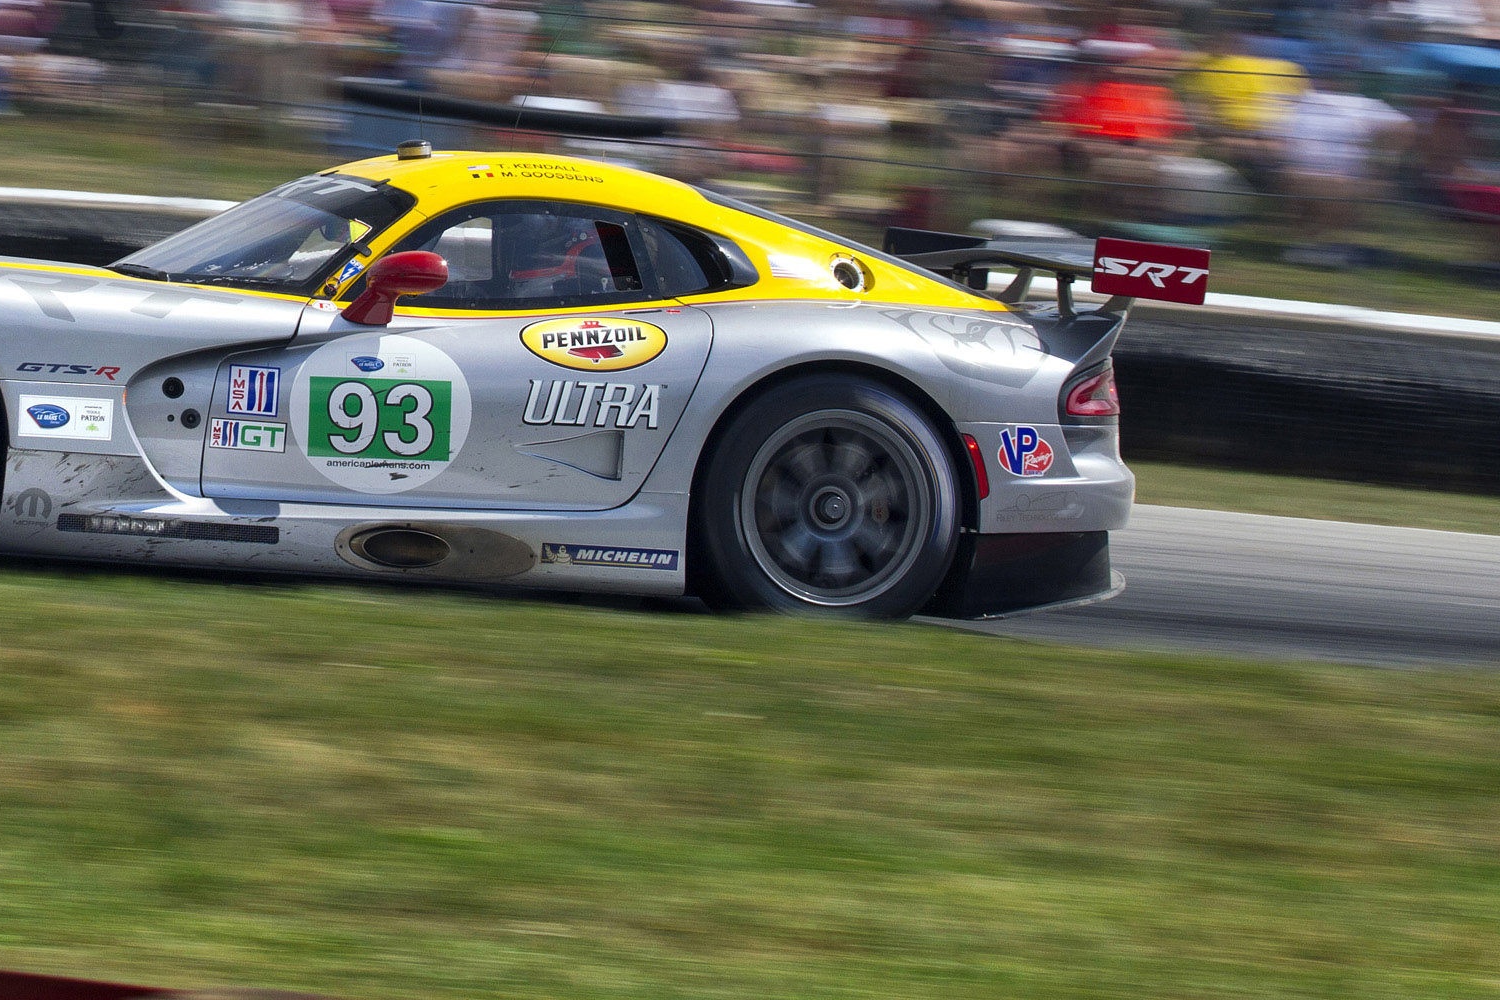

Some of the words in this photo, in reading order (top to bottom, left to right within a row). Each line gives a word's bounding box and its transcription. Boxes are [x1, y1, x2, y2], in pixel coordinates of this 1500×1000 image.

[513, 163, 581, 172] KENDALL
[1094, 256, 1210, 288] SRT
[542, 326, 647, 349] PENNZOIL
[16, 362, 121, 381] GTS-R
[231, 368, 246, 411] IMSA
[522, 378, 660, 430] ULTRA
[327, 380, 435, 457] 93
[212, 420, 222, 446] IMSA
[240, 425, 285, 448] GT
[999, 426, 1039, 475] VP
[576, 549, 673, 565] MICHELIN
